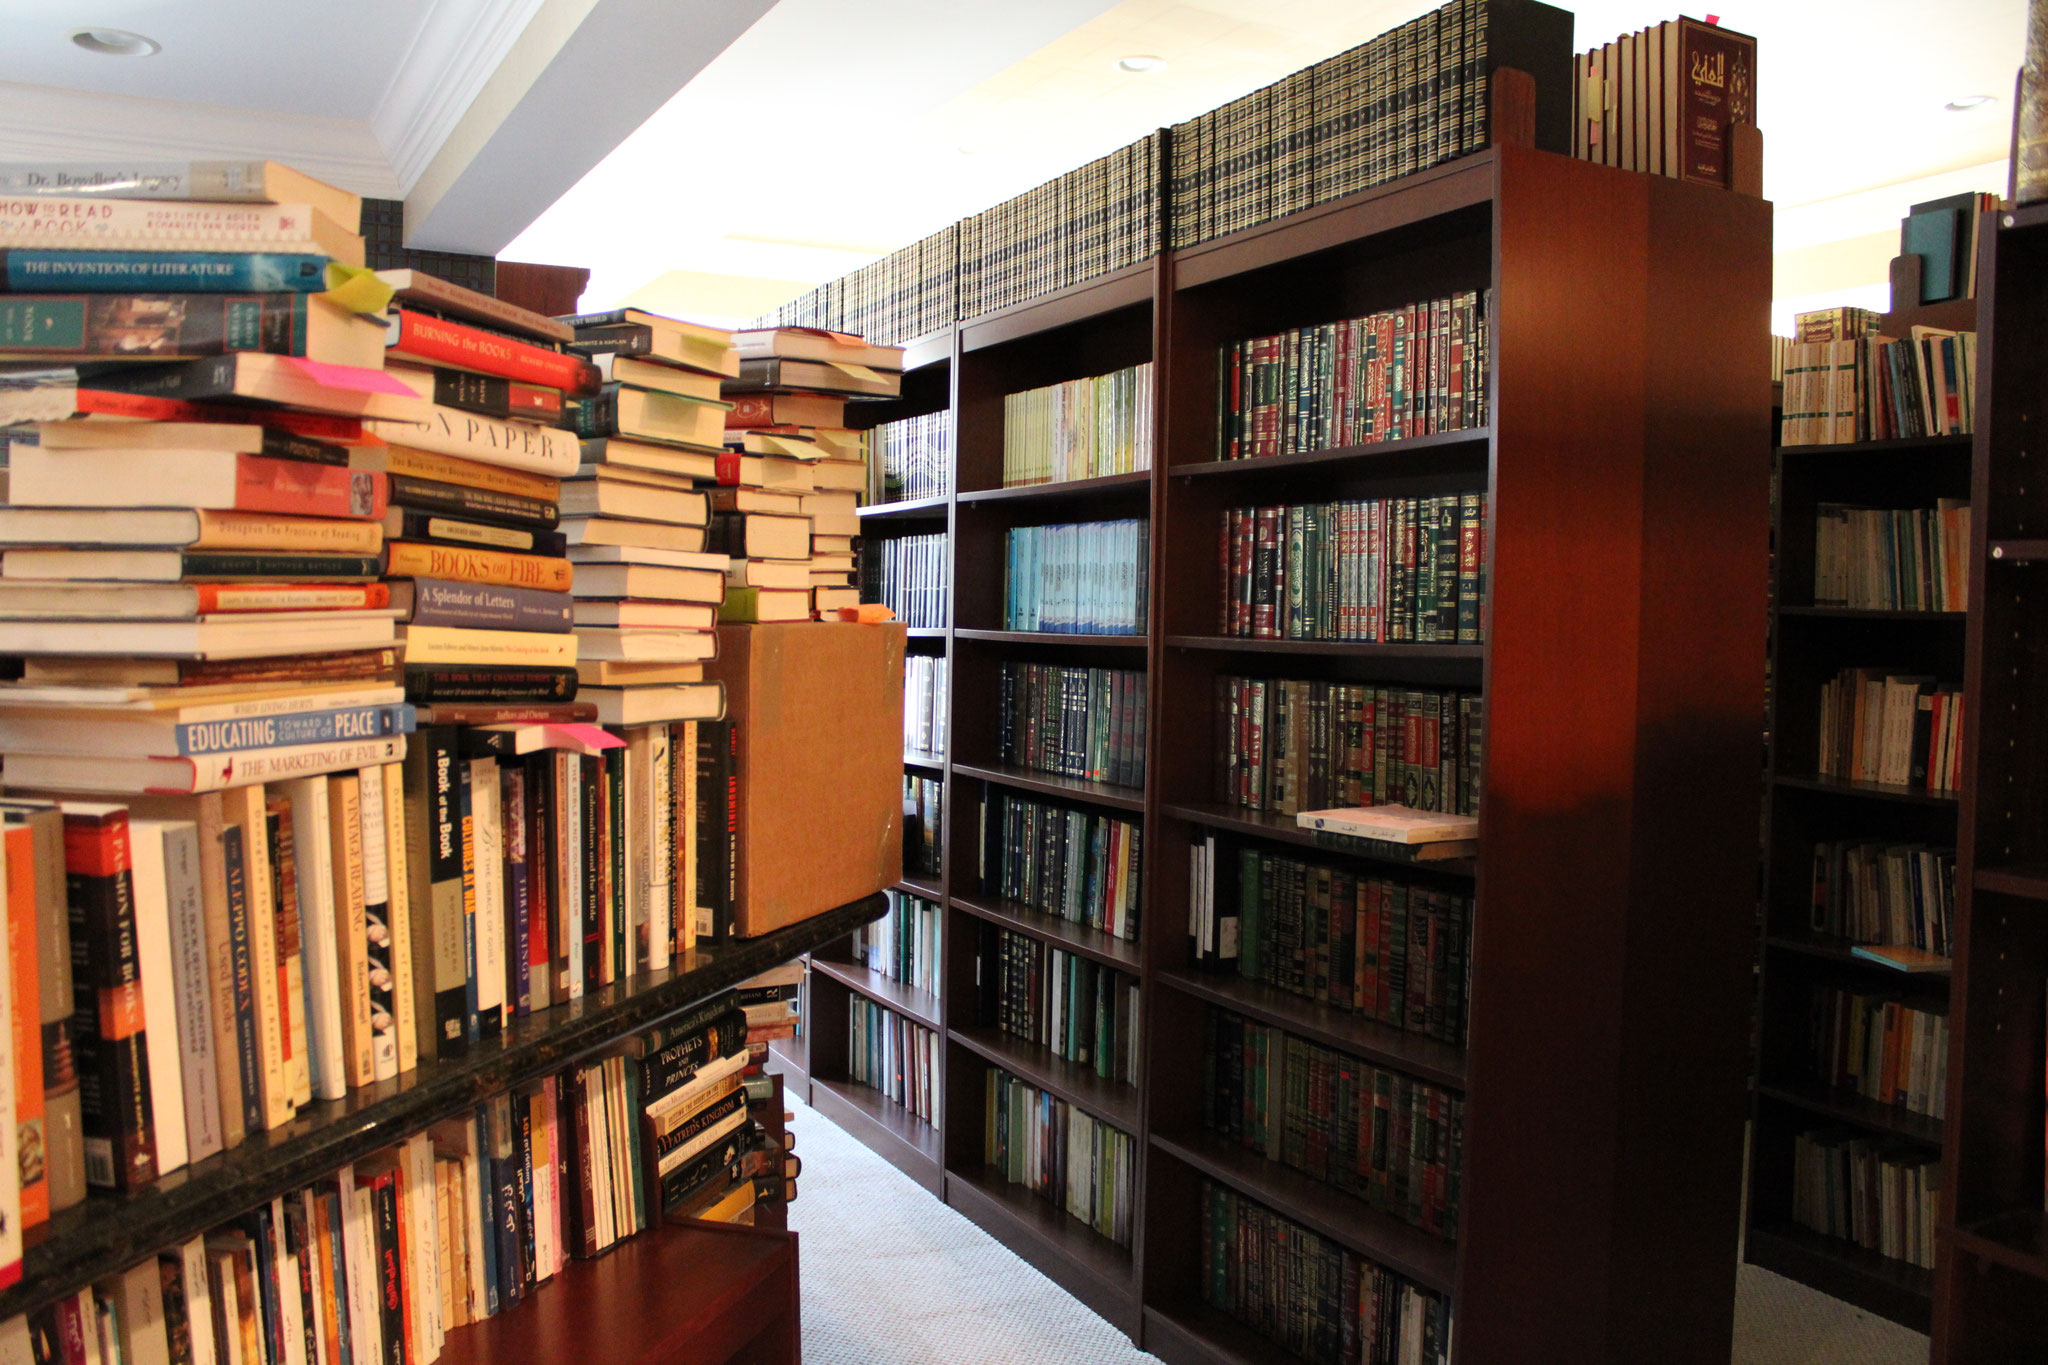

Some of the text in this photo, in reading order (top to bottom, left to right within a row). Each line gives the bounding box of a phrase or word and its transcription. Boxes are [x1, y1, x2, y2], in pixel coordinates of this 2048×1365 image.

[27, 172, 50, 187] Dr.
[57, 171, 126, 188] Bowdler's
[60, 203, 113, 219] READ
[24, 260, 234, 276] THE INVENTION OF LITERATURE
[413, 322, 459, 347] BURNING
[462, 337, 477, 351] the
[479, 340, 512, 361] BOOKS
[467, 418, 553, 460] PAPER
[430, 550, 546, 585] BOOKS on FIRE
[421, 586, 515, 609] A Splendor of Letters
[187, 712, 374, 752] EDUCATING PEACE
[278, 728, 332, 741] CULTURE OF
[279, 718, 321, 731] TOWARD
[240, 744, 380, 779] THE MARKETING OF EVIL
[437, 749, 452, 859] A Book of the Book
[588, 785, 596, 849] Colonialism
[462, 816, 474, 871] CULTURES
[113, 838, 129, 916] PASSION
[347, 795, 363, 932] VINTAGE READING
[463, 873, 475, 886] AT
[230, 867, 244, 941] ALEPPO
[464, 888, 476, 915] WAR
[118, 920, 133, 958] FOR
[520, 879, 529, 981] THREE KINGS
[236, 945, 249, 1011] CODEX
[660, 1035, 703, 1065] PROPHETS
[678, 1057, 689, 1067] AND
[665, 1061, 700, 1087] PRINCES
[661, 1100, 735, 1152] HATRED'S KINGDOM
